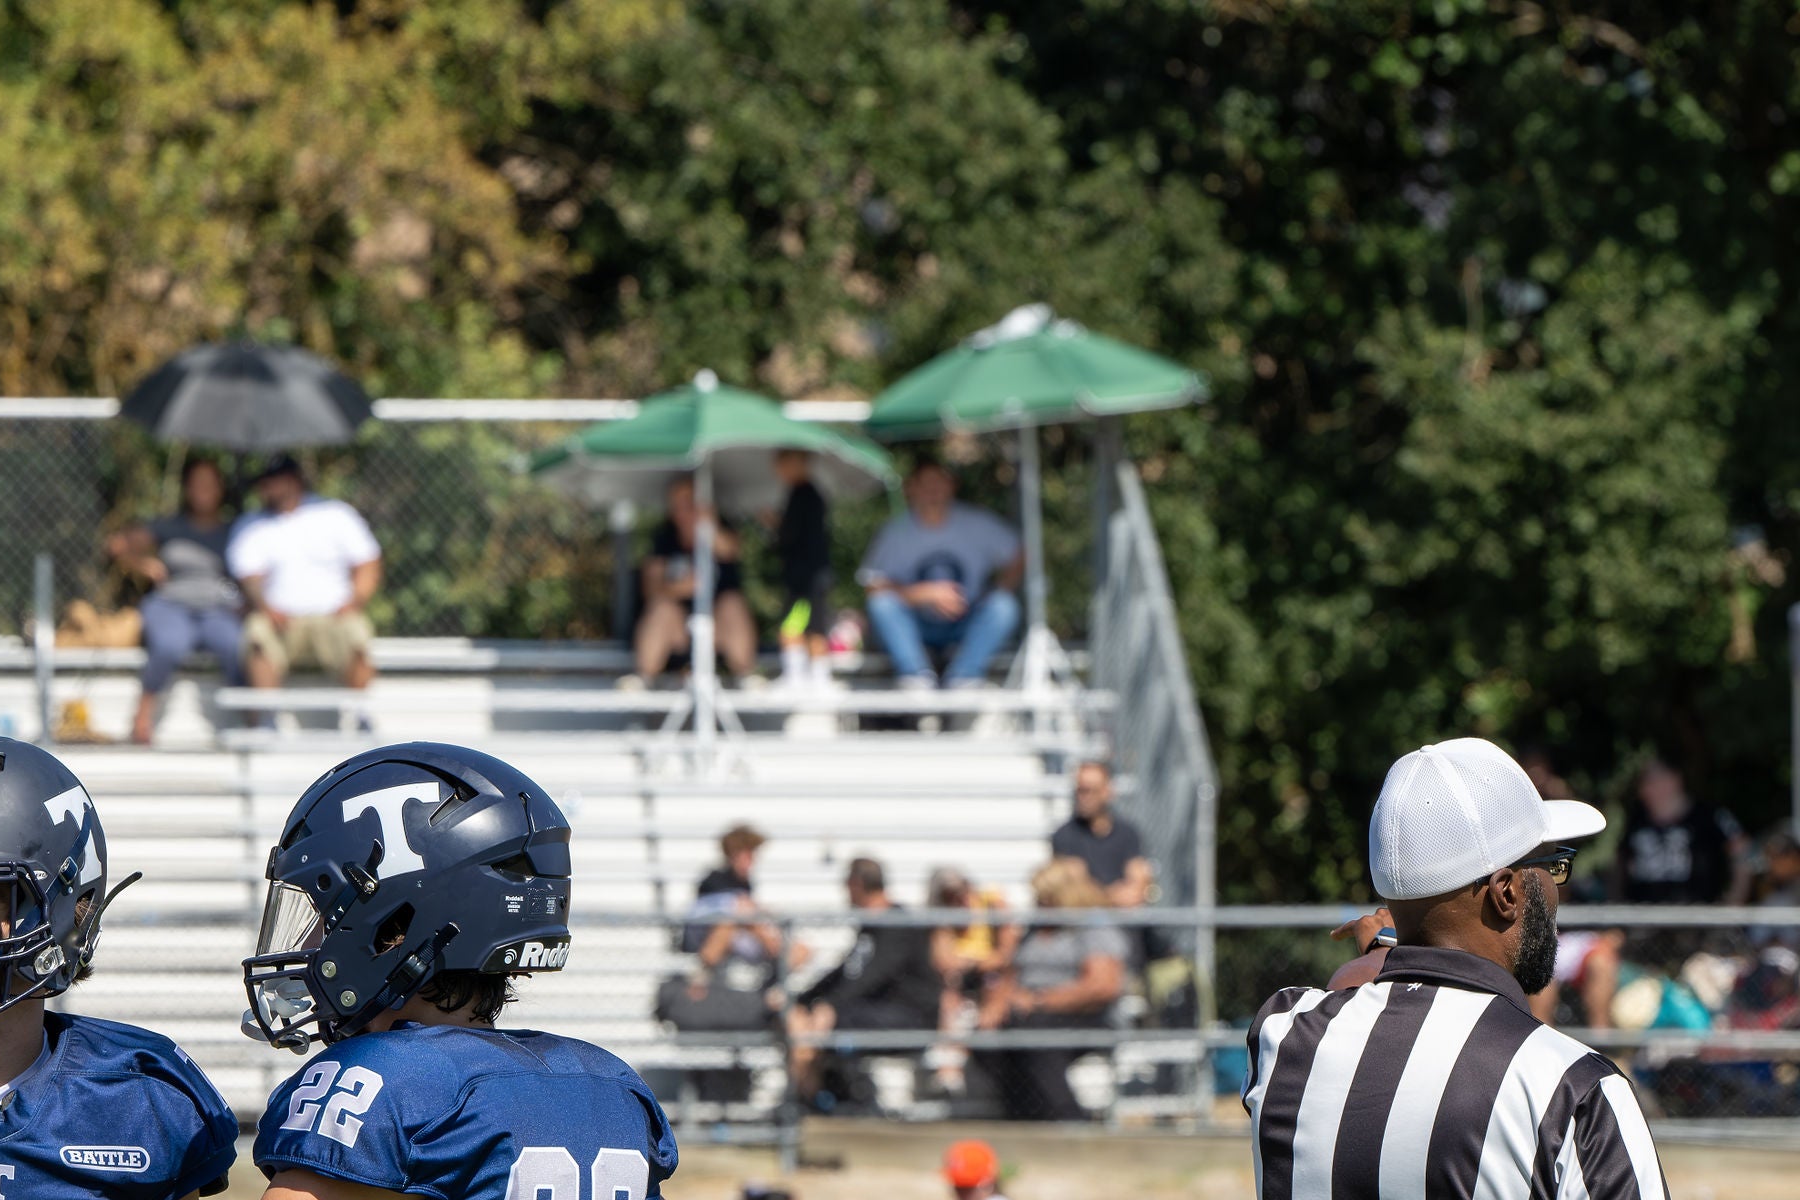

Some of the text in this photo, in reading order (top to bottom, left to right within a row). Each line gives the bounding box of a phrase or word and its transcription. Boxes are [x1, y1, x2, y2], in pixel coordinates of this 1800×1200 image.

[43, 785, 103, 886] T
[342, 782, 441, 880] T
[280, 1061, 383, 1149] 22
[67, 1150, 142, 1167] BATTLE
